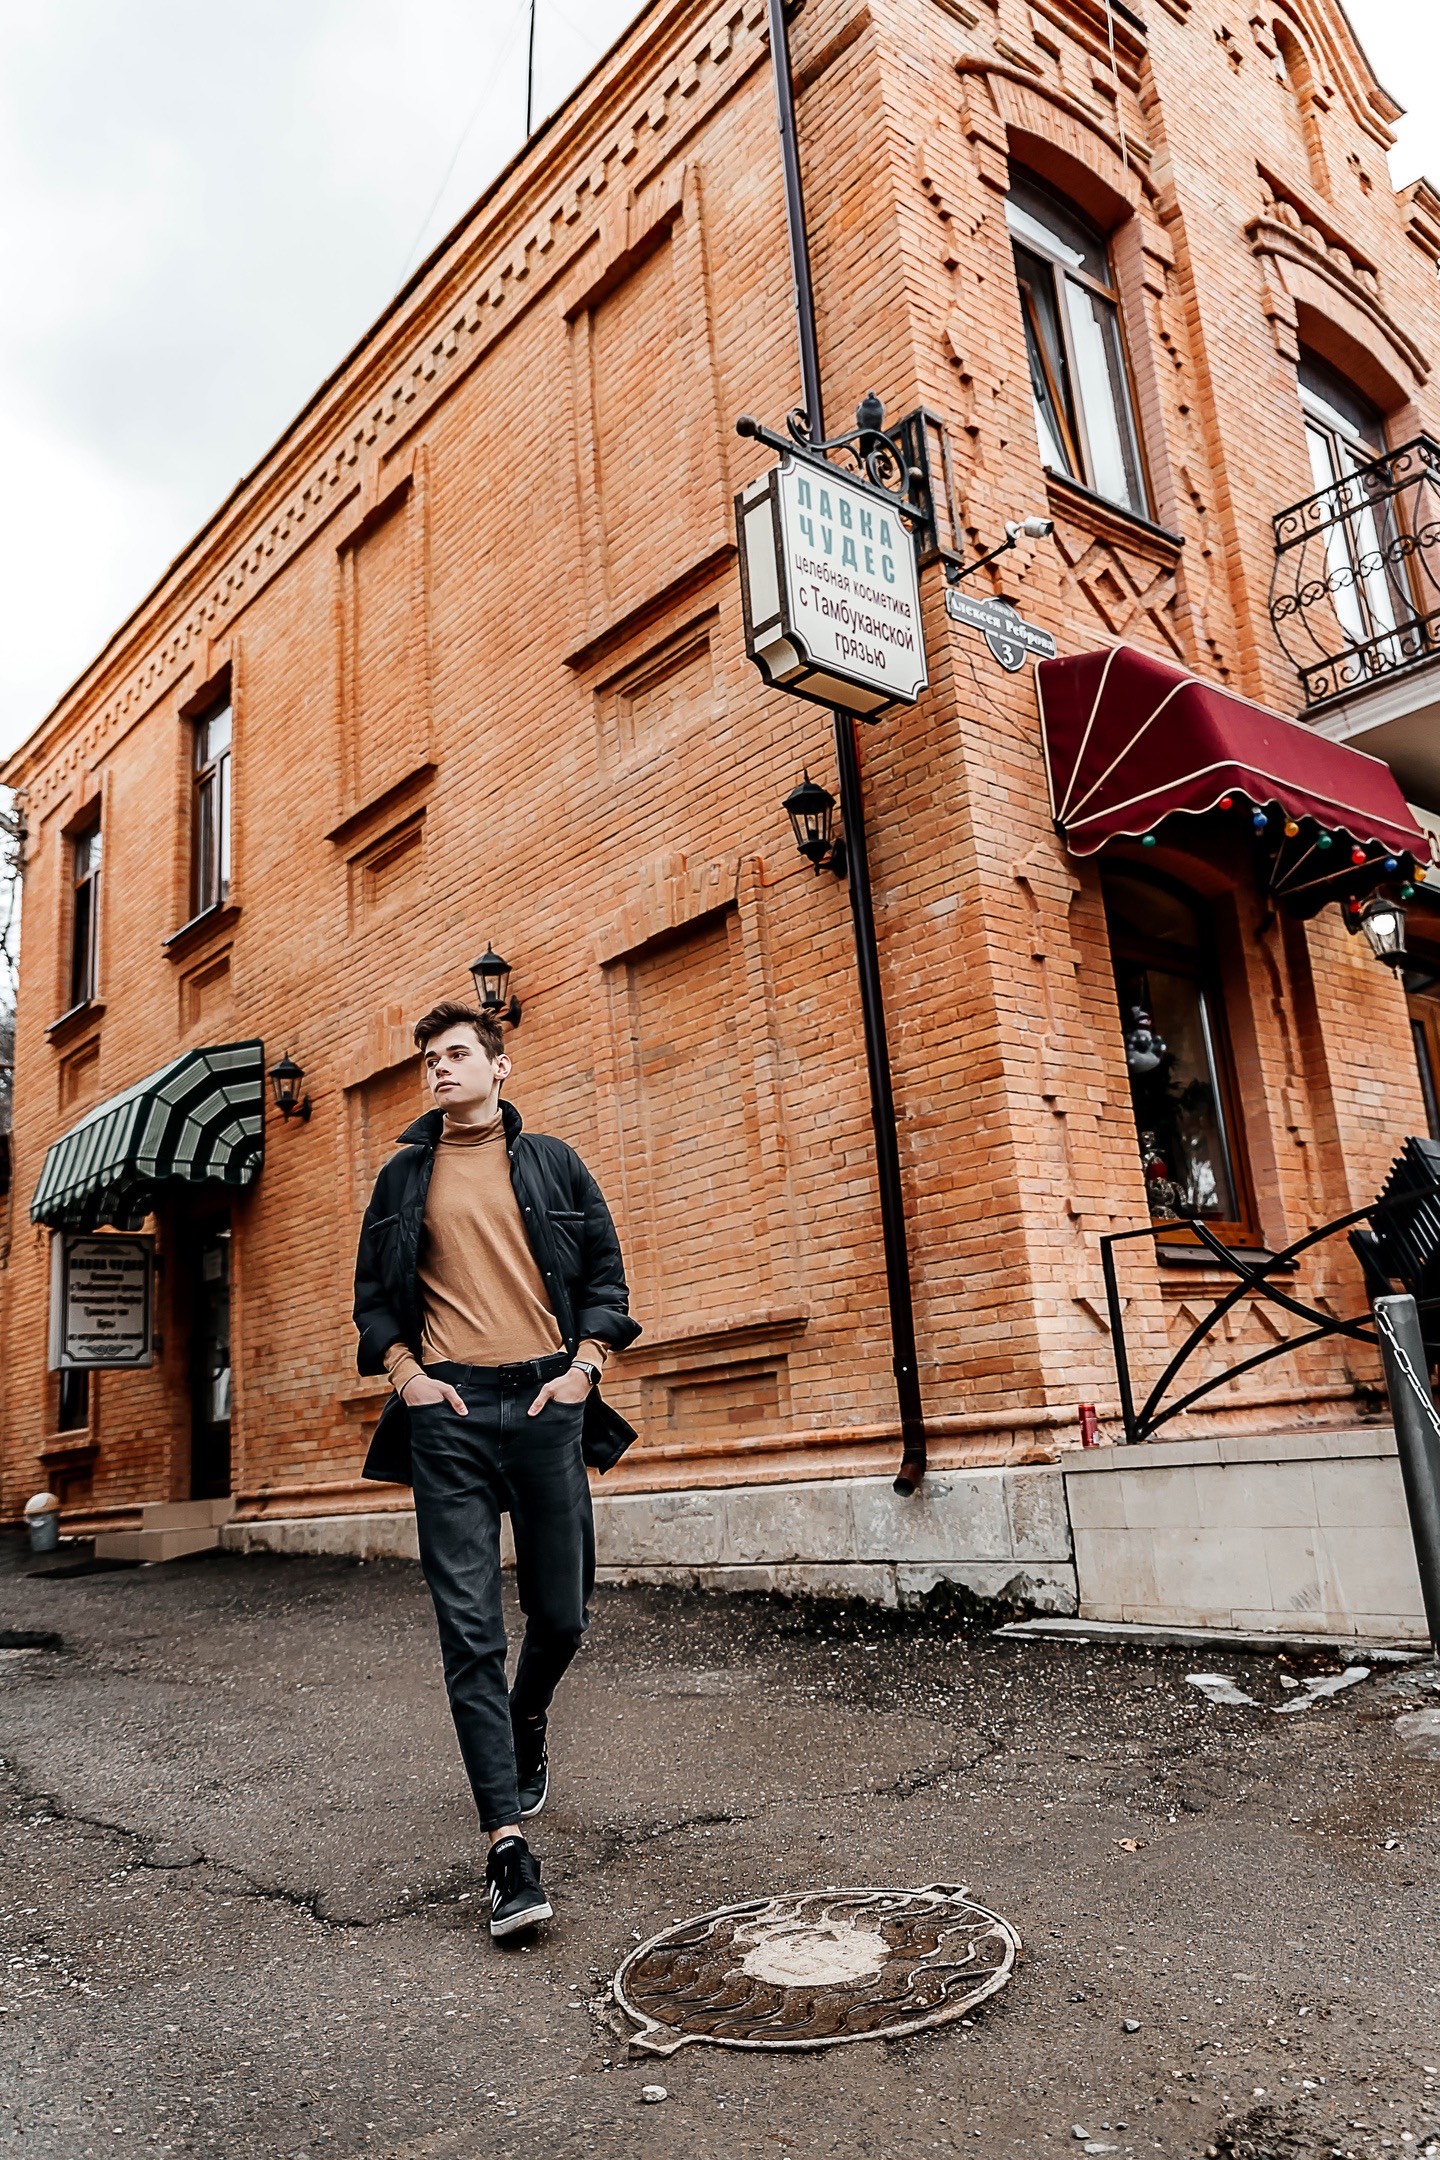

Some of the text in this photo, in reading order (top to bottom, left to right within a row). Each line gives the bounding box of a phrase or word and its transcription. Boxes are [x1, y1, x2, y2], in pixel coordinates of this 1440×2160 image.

[797, 477, 893, 550] ЛАВКА
[799, 513, 895, 584] ЧУДЕС
[795, 554, 911, 618] целебная косметика
[799, 585, 914, 652] с Тамбуканской
[835, 632, 886, 669] грязью
[1001, 643, 1014, 664] 3
